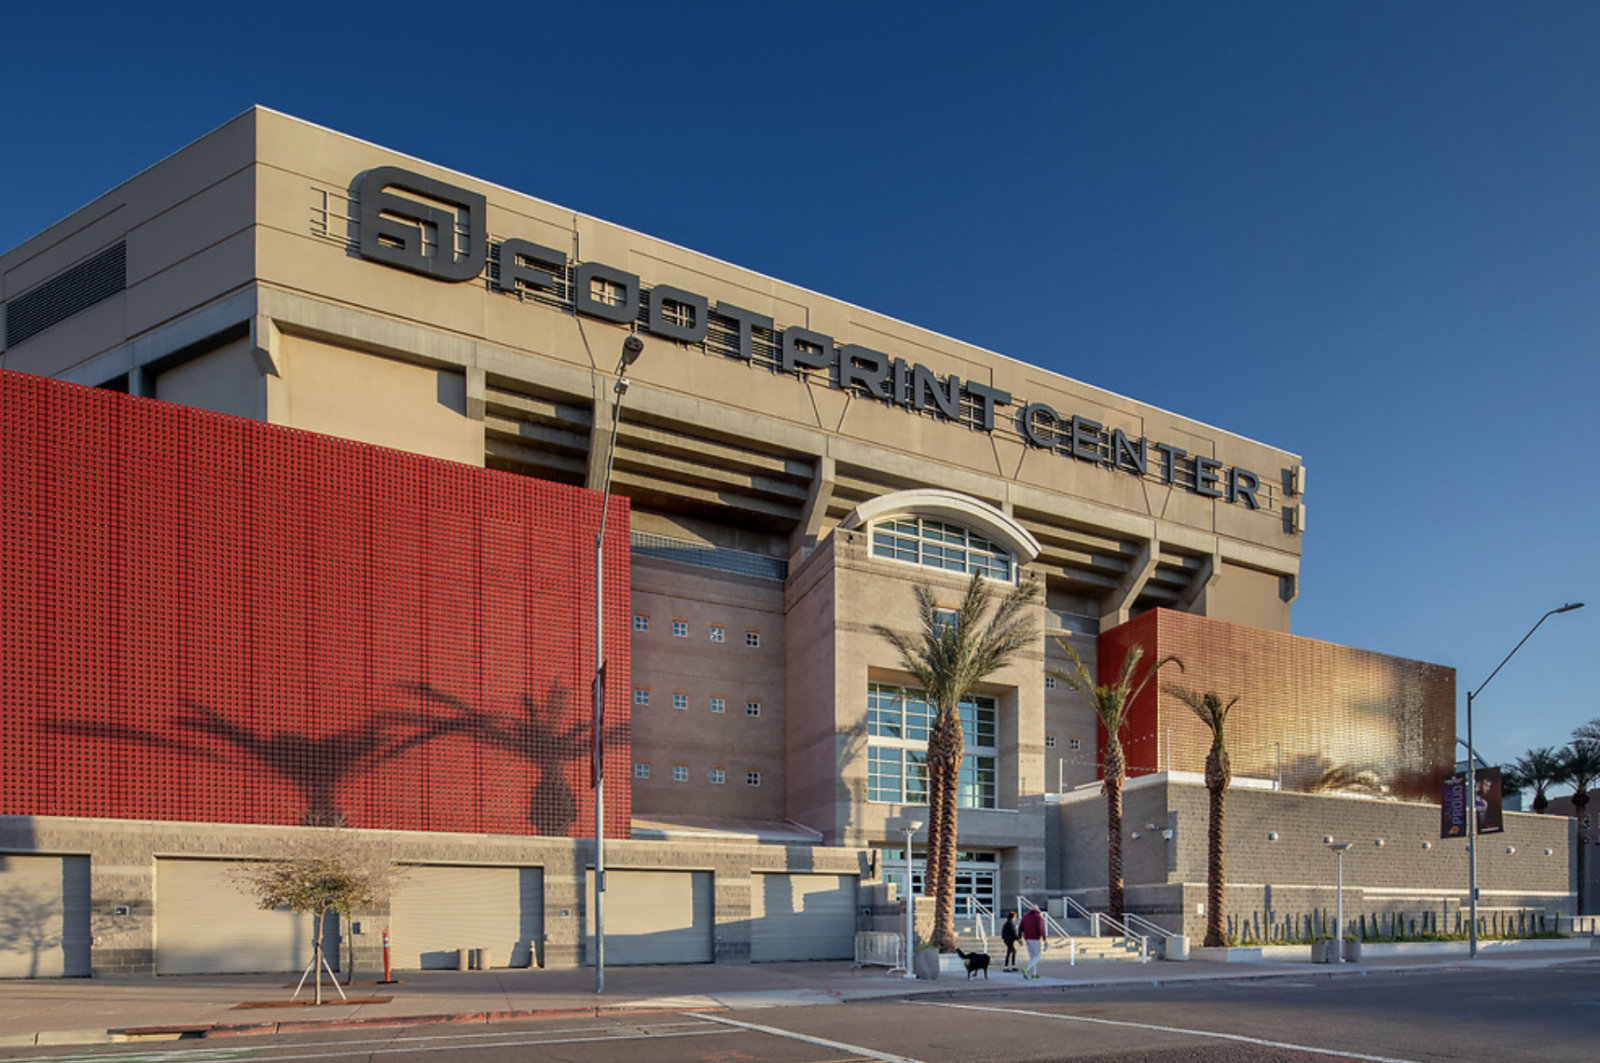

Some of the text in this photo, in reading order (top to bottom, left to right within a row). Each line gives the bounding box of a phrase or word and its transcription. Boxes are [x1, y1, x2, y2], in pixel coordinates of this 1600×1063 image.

[500, 237, 1260, 510] FOOTPRINT CENTER
[1452, 785, 1463, 825] PROUD
